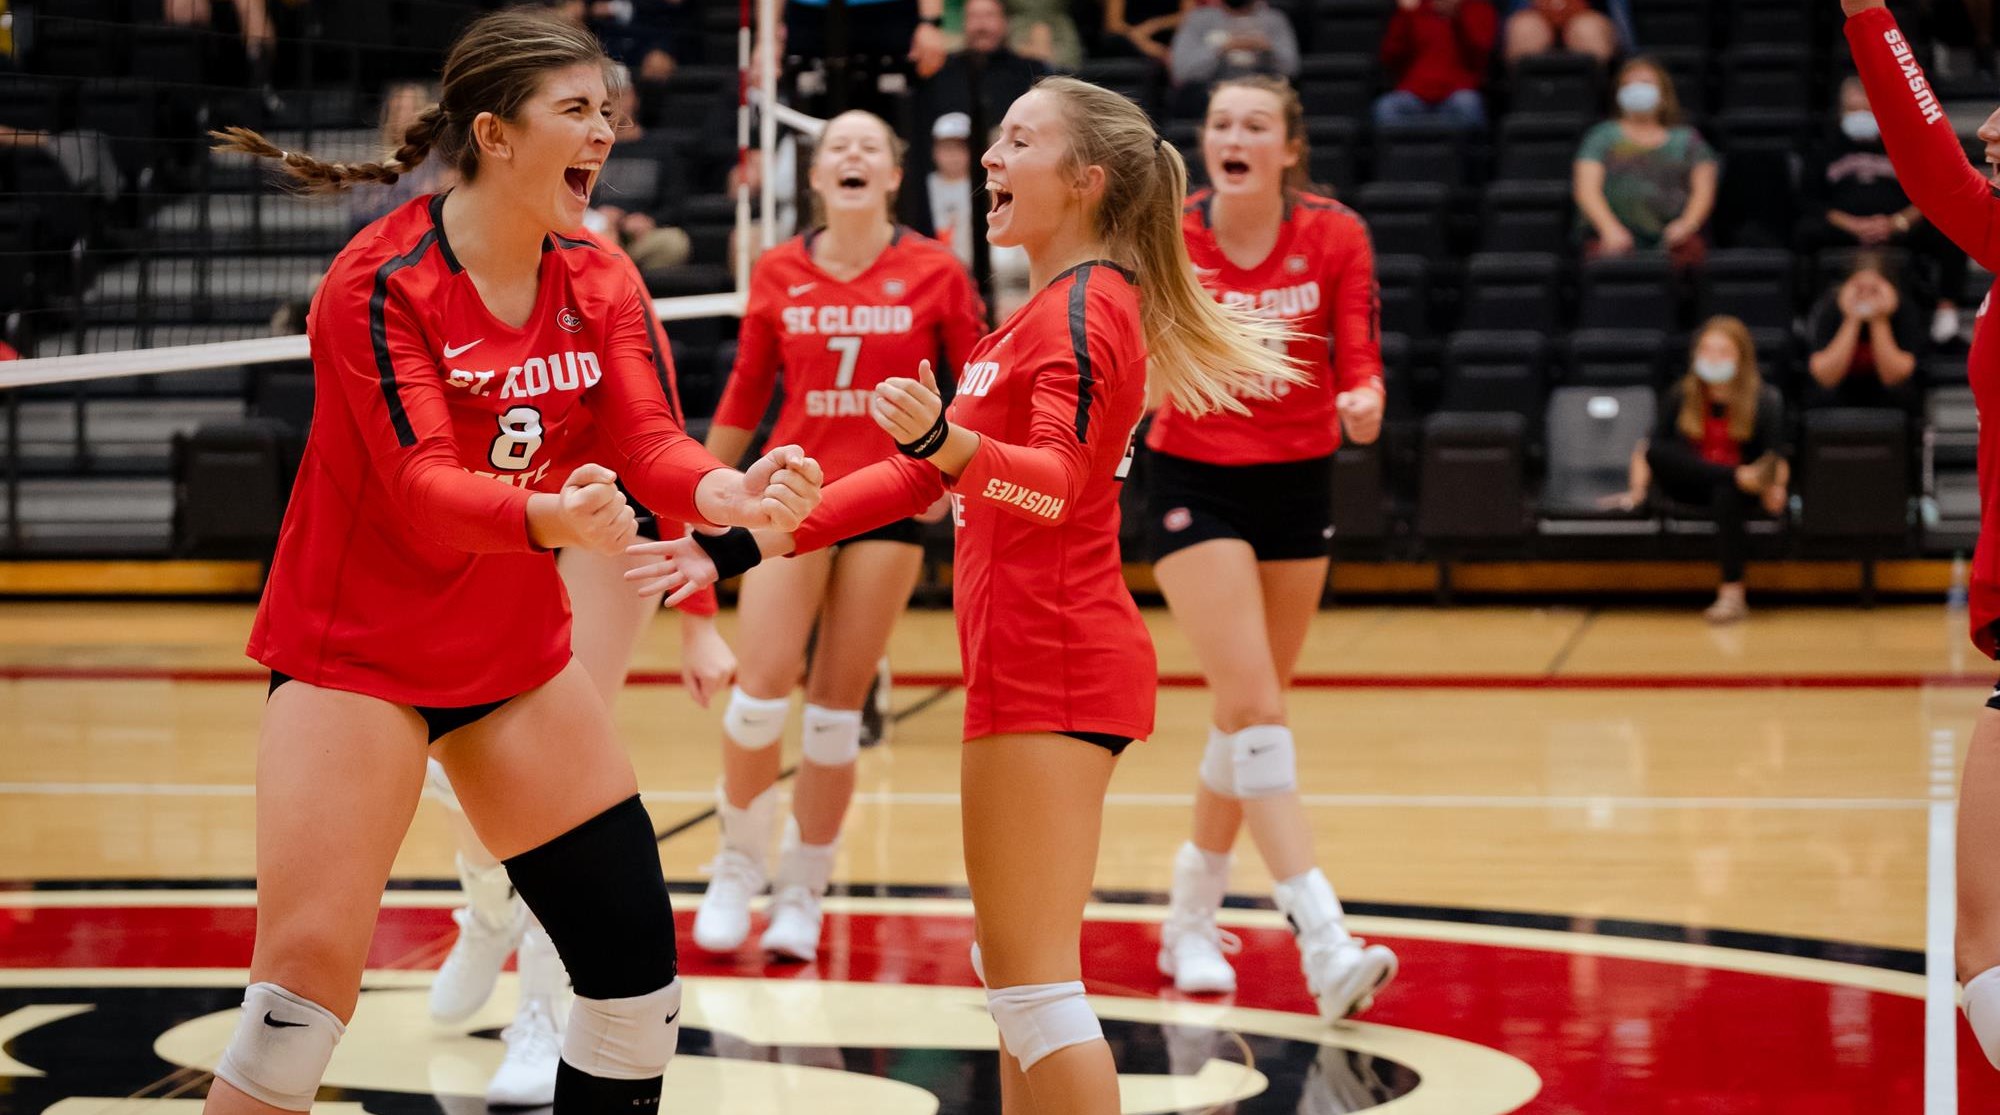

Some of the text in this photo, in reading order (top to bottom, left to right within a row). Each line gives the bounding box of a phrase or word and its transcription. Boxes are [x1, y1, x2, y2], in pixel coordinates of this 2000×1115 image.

[1883, 28, 1943, 125] HUSKIES
[781, 305, 913, 334] ST. CLOUD
[827, 336, 862, 389] 7
[805, 390, 877, 417] STAT
[488, 404, 546, 471] 8
[981, 477, 1065, 519] HUSKIES
